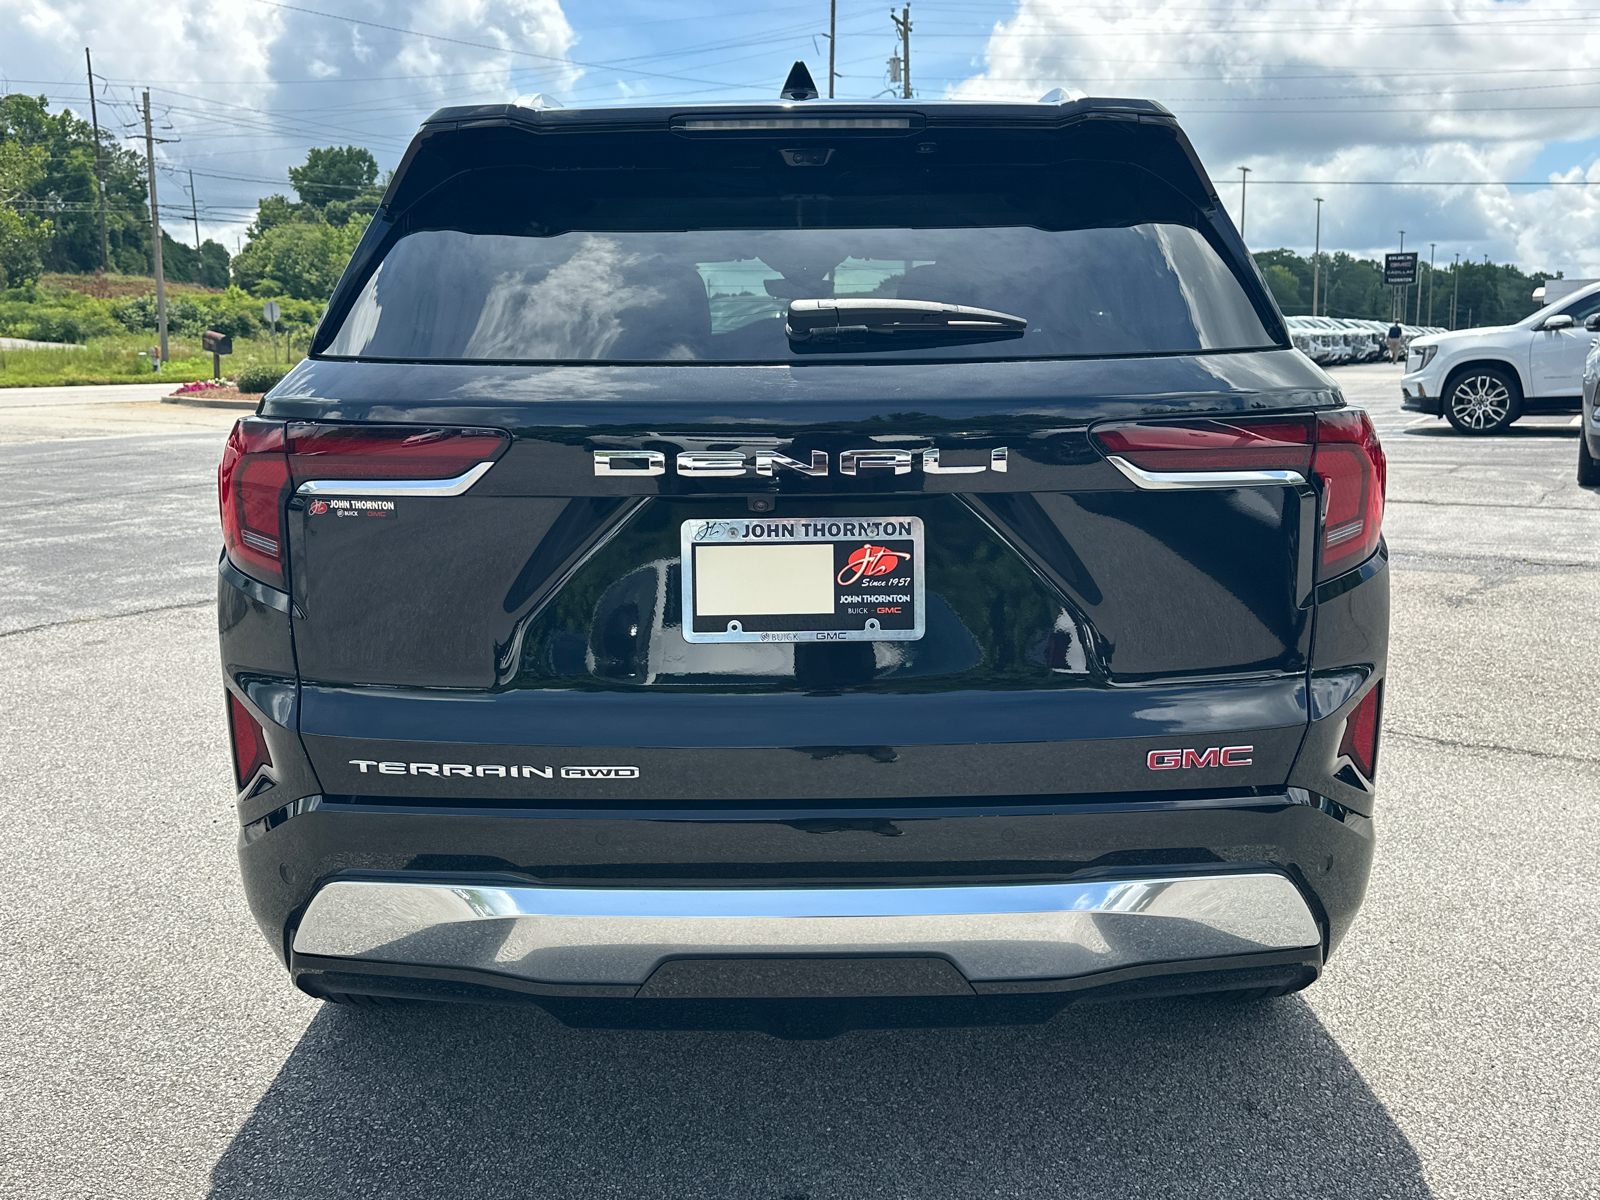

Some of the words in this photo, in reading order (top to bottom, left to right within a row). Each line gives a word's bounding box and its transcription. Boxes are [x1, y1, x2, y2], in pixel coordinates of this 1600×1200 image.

[594, 446, 1009, 477] DENALI
[329, 499, 350, 509] JOHN
[351, 500, 394, 510] THORNTON
[742, 523, 795, 538] JOHN
[802, 521, 912, 537] THORNTON
[861, 578, 887, 587] Since
[888, 577, 911, 587] 1957
[839, 595, 862, 604] JOHN
[862, 594, 911, 603] THORNTON
[847, 607, 869, 615] BUICK
[876, 606, 902, 614] GMC
[771, 632, 799, 642] BUICK
[816, 632, 847, 640] GMC
[1147, 745, 1254, 770] GMC
[348, 759, 554, 779] TERRAIN
[562, 766, 638, 778] AWD
